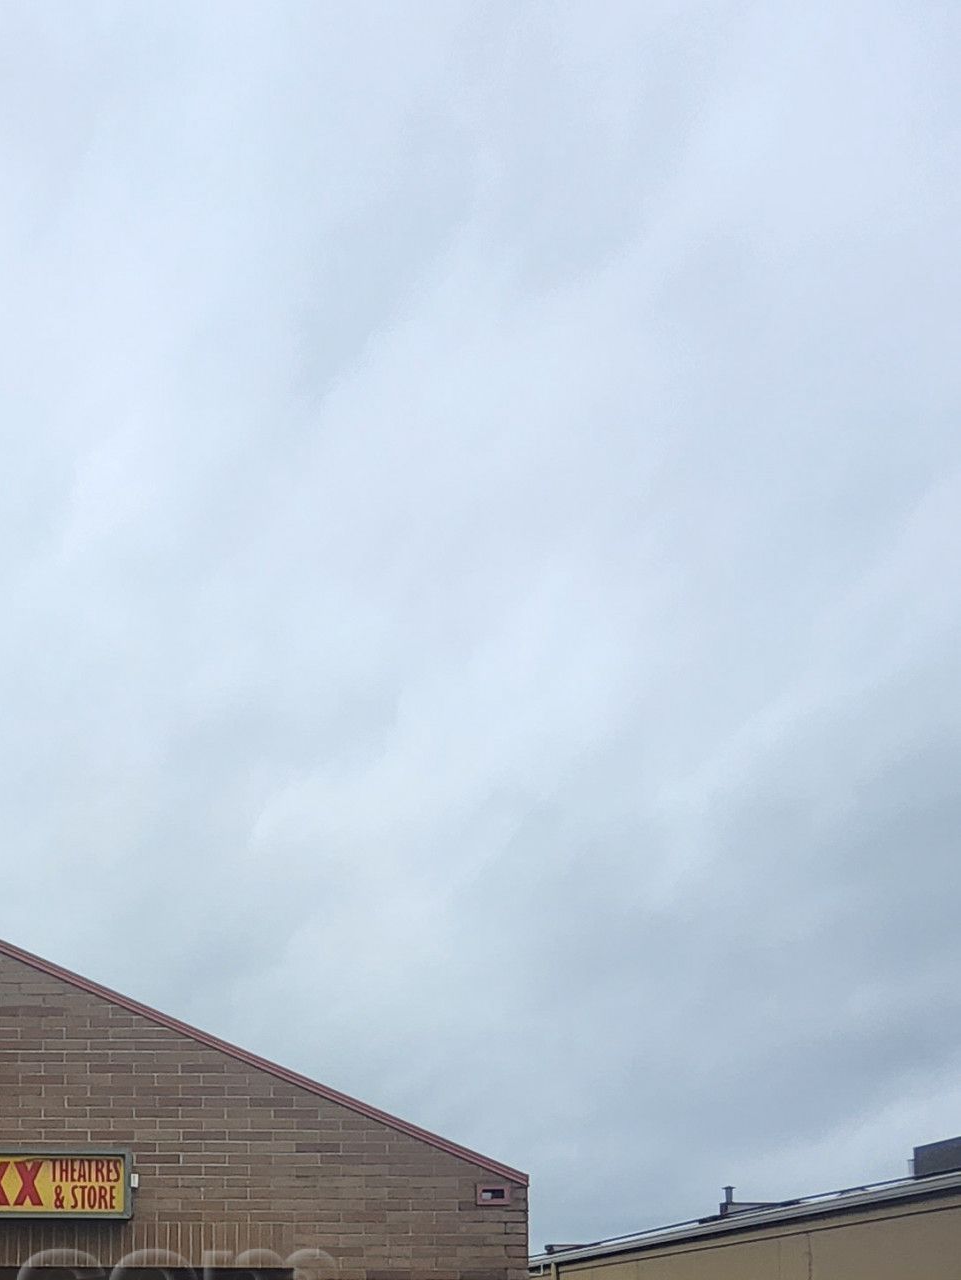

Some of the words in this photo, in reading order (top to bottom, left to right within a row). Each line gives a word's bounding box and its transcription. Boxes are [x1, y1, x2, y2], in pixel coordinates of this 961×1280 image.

[50, 1158, 122, 1183] THEATRES
[54, 1186, 65, 1210] &
[70, 1185, 116, 1210] STORE
